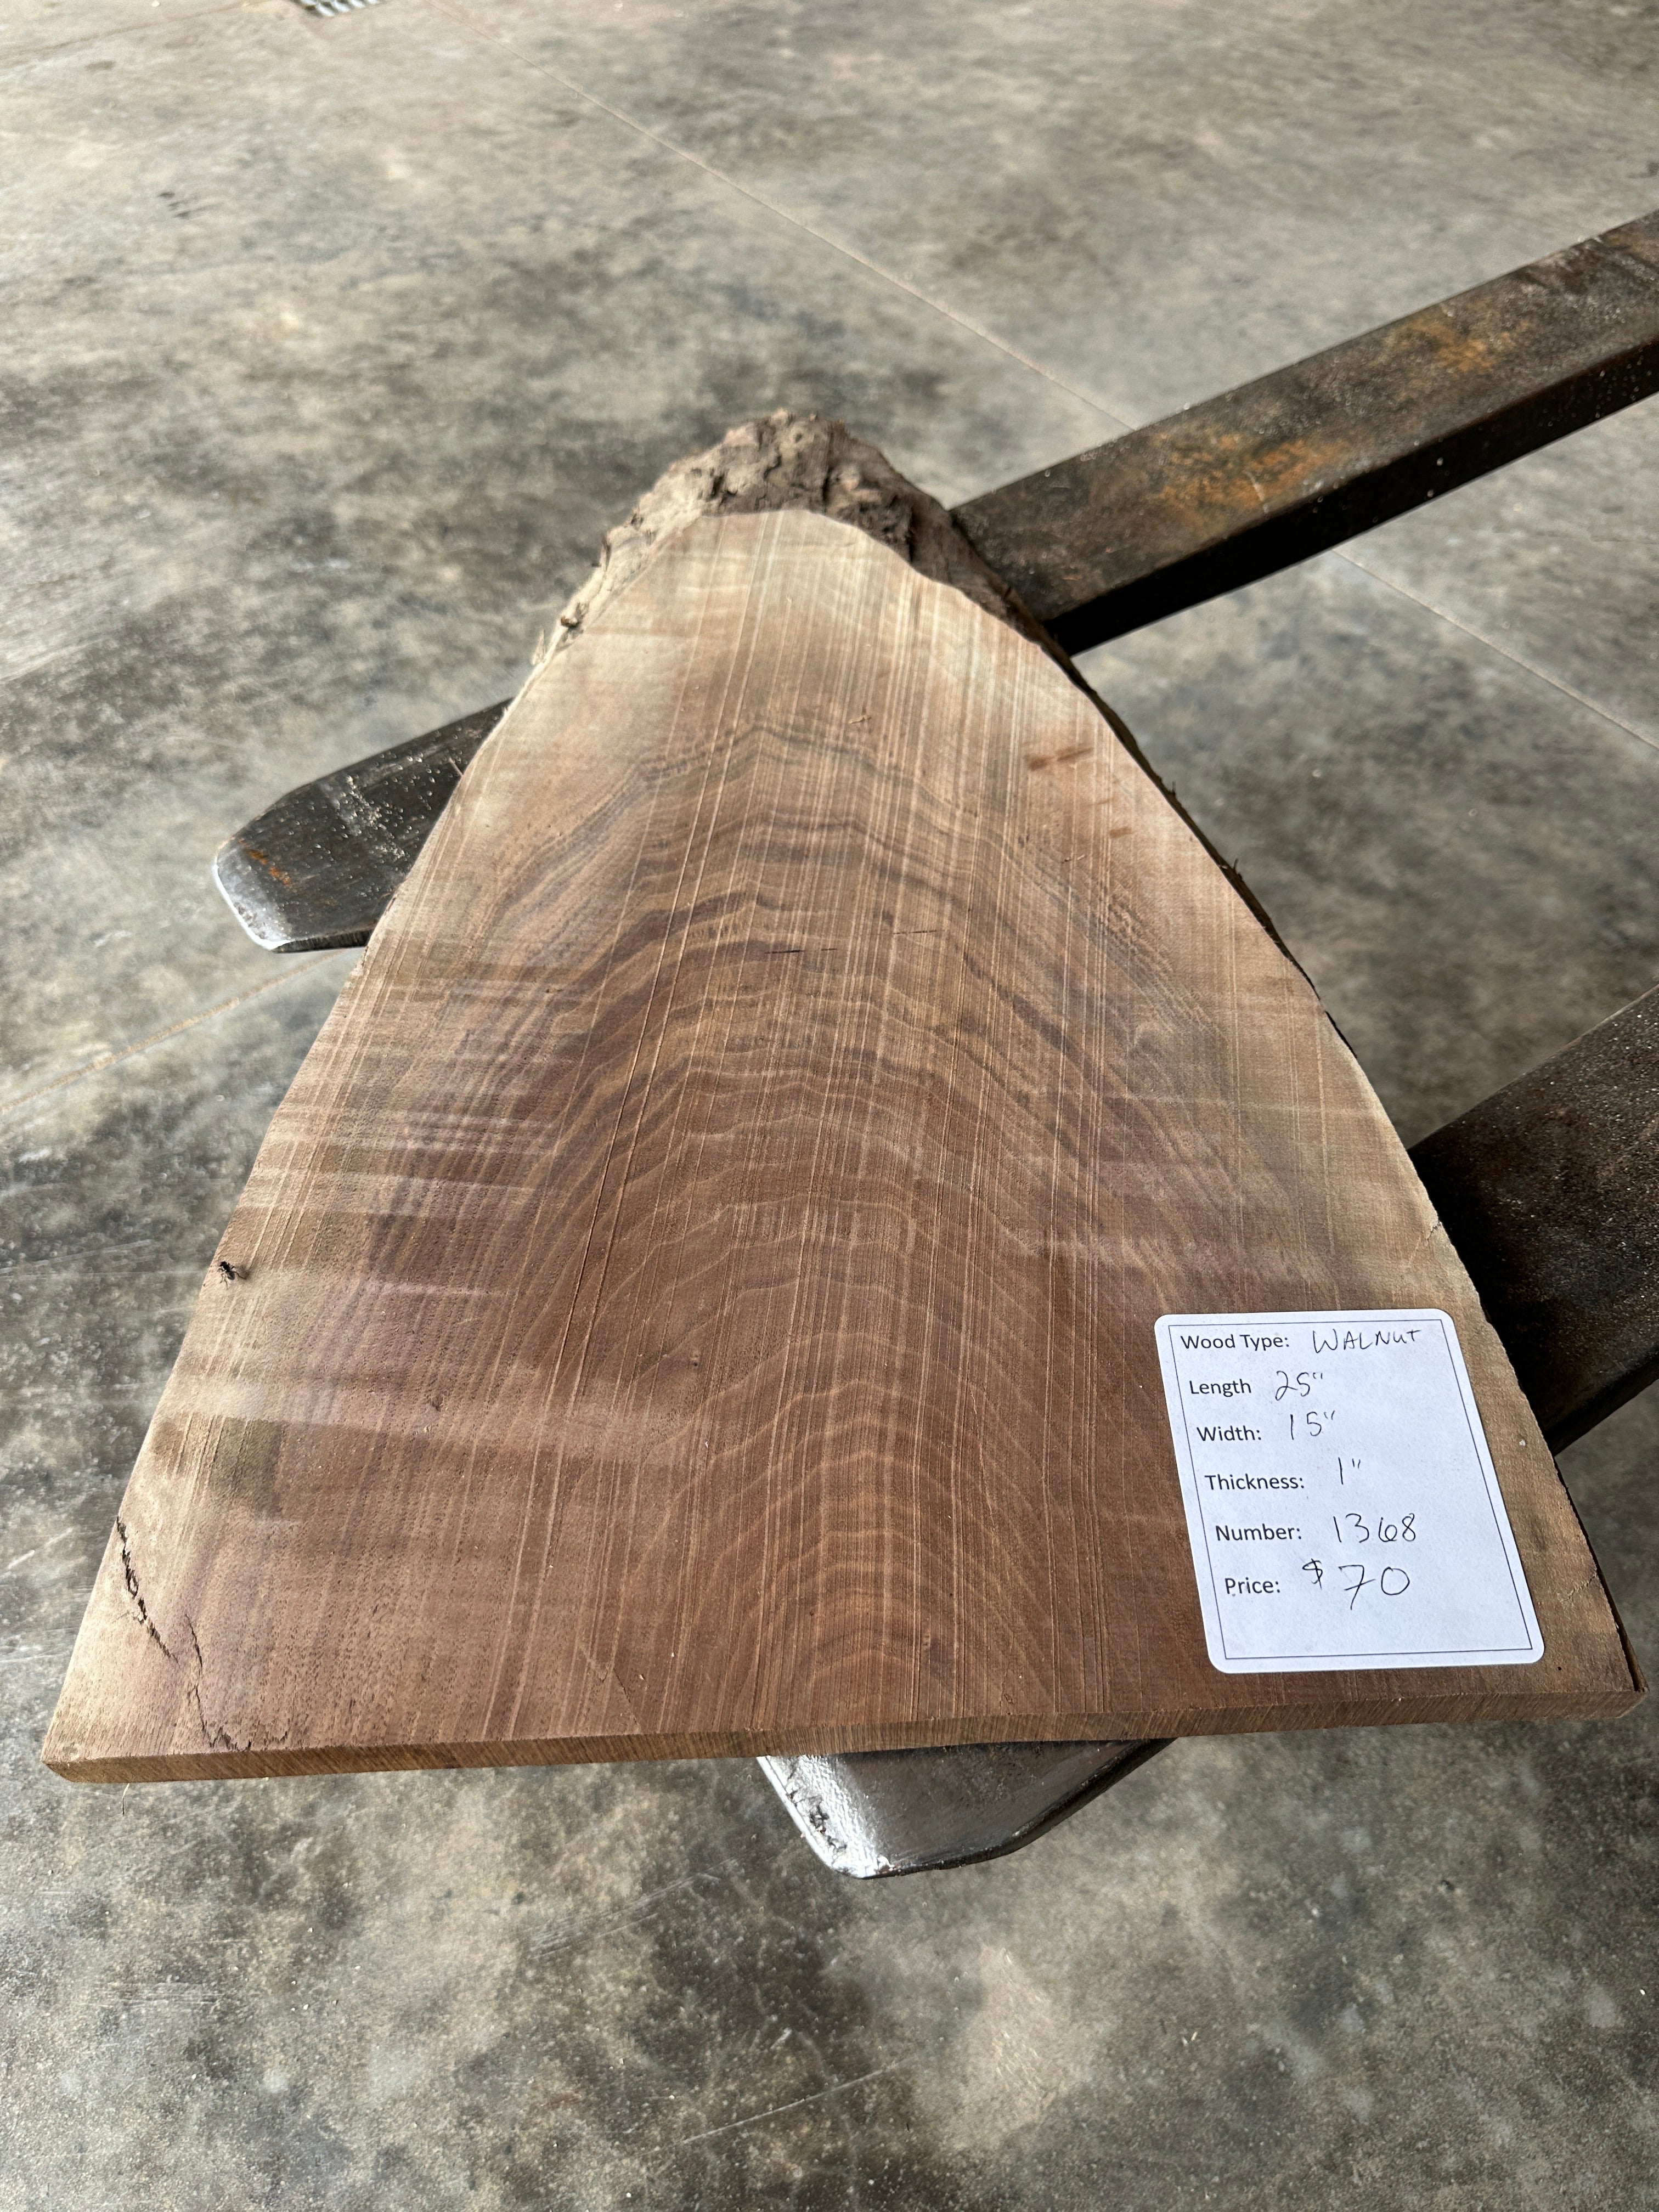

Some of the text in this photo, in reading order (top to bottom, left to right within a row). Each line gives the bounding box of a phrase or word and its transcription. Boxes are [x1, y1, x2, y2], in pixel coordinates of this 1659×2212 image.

[1180, 1333, 1236, 1350] Wood
[1239, 1334, 1290, 1352] Type:
[1189, 1369, 1324, 1402] Length 25"
[1196, 1410, 1336, 1442] Width: 15"
[1204, 1472, 1305, 1491] Thickness:
[1215, 1512, 1417, 1544] Number: 1368
[1224, 1576, 1282, 1595] Price:
